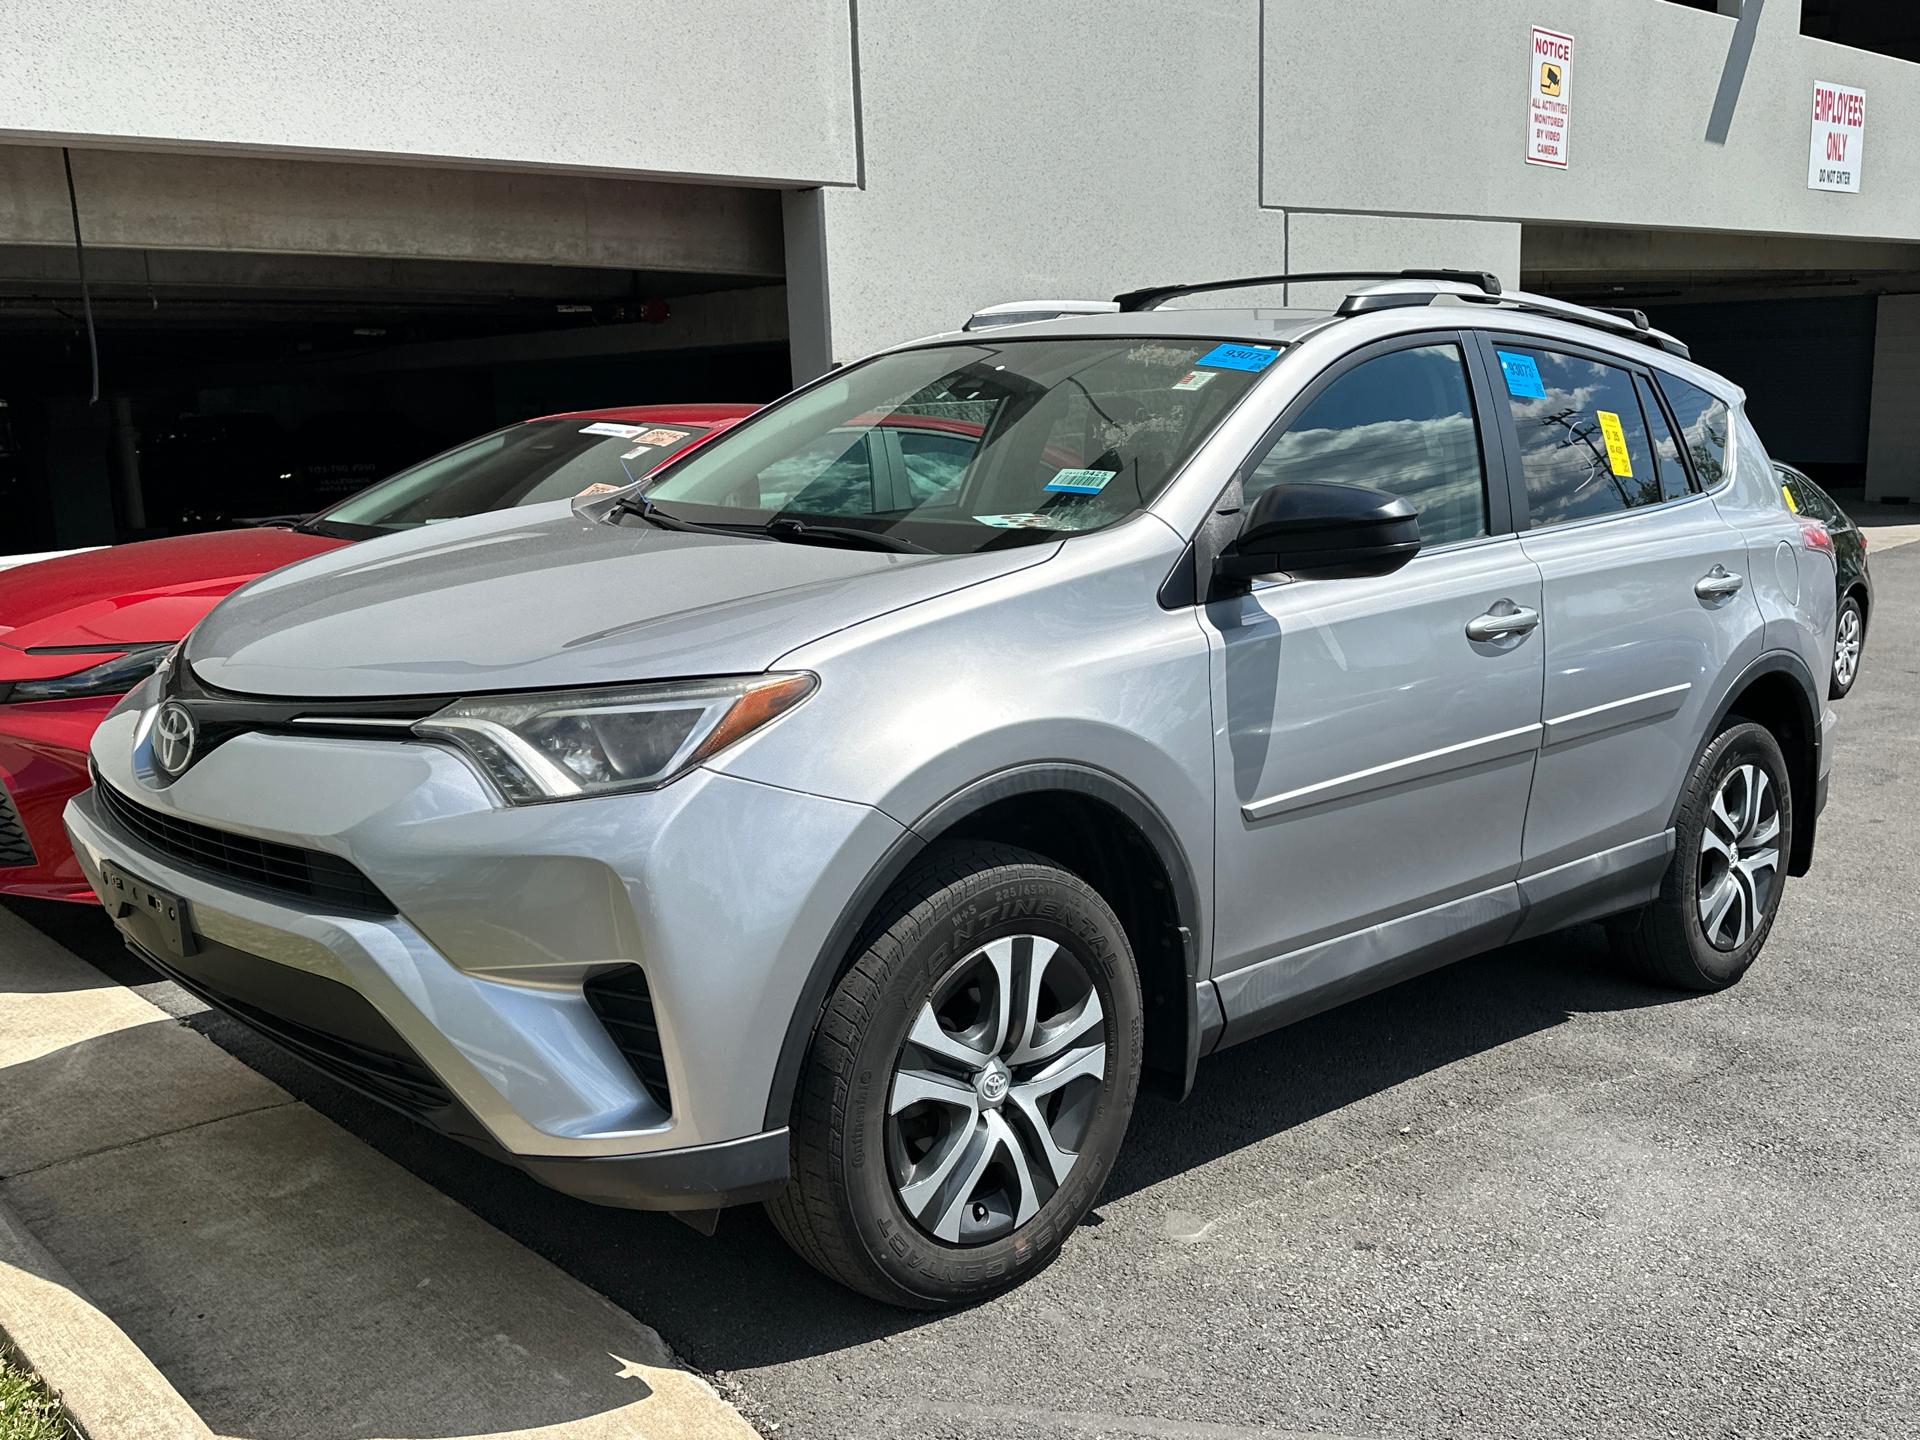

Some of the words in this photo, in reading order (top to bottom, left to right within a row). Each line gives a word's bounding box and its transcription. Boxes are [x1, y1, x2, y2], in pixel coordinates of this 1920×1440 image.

[1535, 38, 1569, 61] NOTICE
[1532, 98, 1541, 110] ALL
[1542, 100, 1568, 115] ACTIVITIES
[1814, 88, 1863, 127] EMPLOYEES
[1534, 113, 1564, 128] MONITORED
[1536, 128, 1544, 139] BY
[1545, 130, 1560, 142] VIDEO
[1537, 143, 1558, 157] CAMERA
[1826, 131, 1848, 162] ONLY
[1819, 169, 1826, 183] DO
[1827, 170, 1836, 184] NOT
[1836, 171, 1851, 185] ENTER
[1222, 349, 1272, 362] 93073
[1508, 361, 1534, 379] 93073
[951, 904, 978, 927] M+S
[903, 897, 1118, 1010] CONTINENTAL
